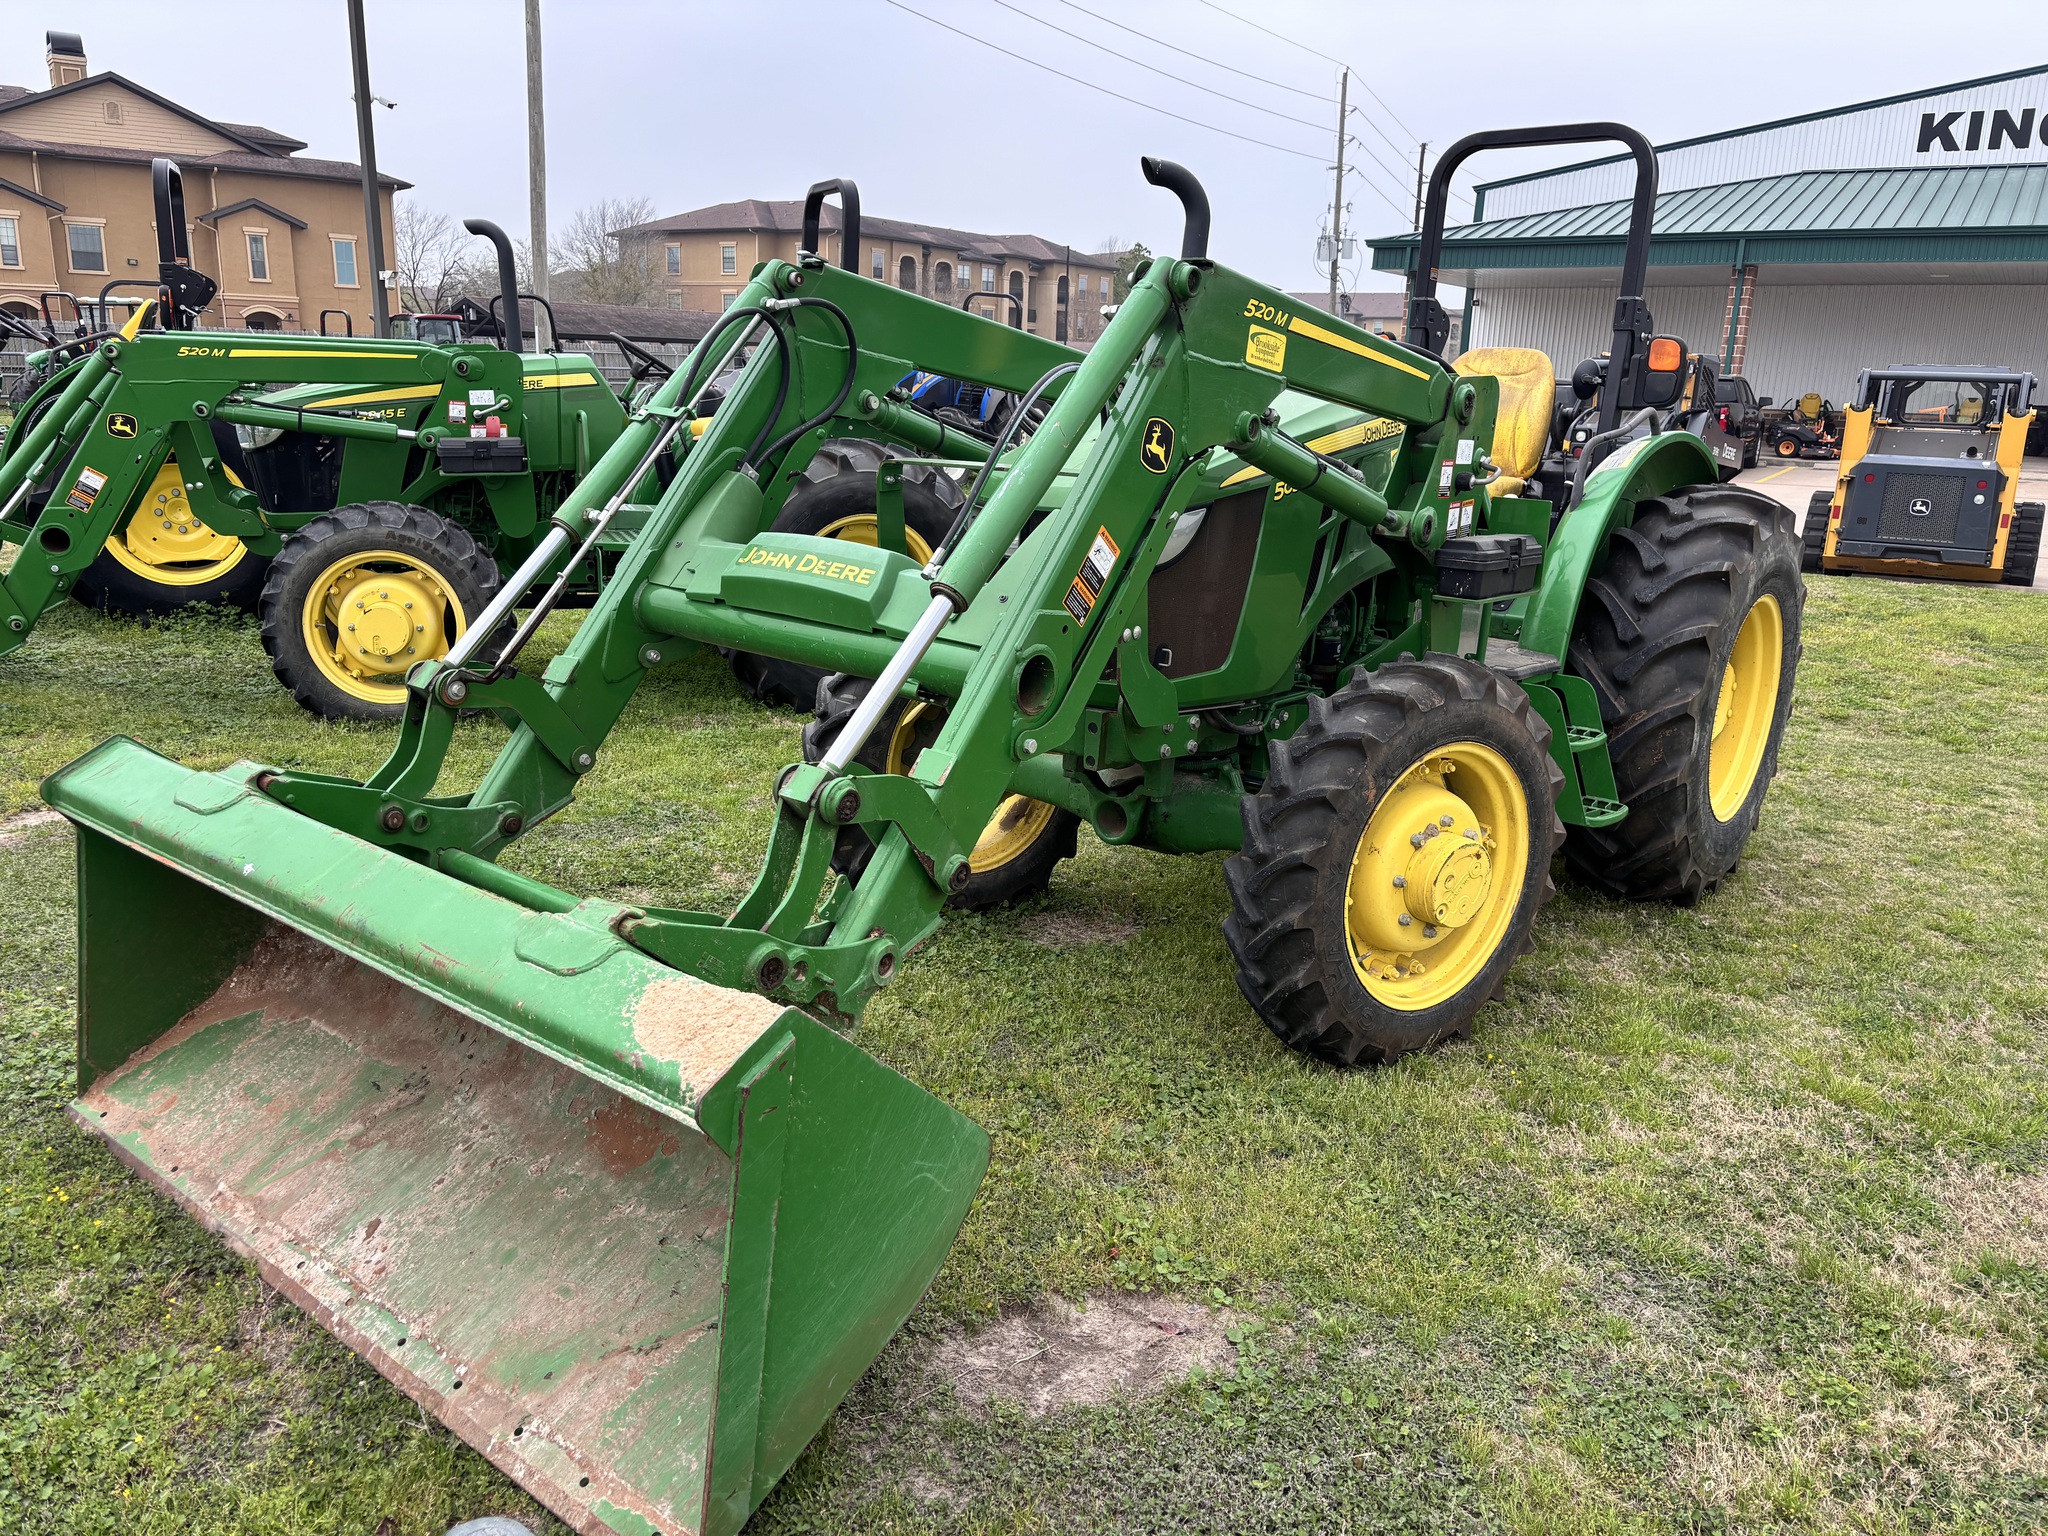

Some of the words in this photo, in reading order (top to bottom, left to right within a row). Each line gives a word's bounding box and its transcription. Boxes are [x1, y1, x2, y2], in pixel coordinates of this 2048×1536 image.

[1917, 108, 2048, 152] KIN
[1243, 298, 1275, 321] 520
[177, 346, 210, 357] 520
[1363, 425, 1382, 442] JOHN
[1381, 420, 1402, 436] DEERE
[1722, 442, 1737, 460] DEERE
[738, 547, 797, 569] JOHN
[796, 553, 876, 585] DEERE
